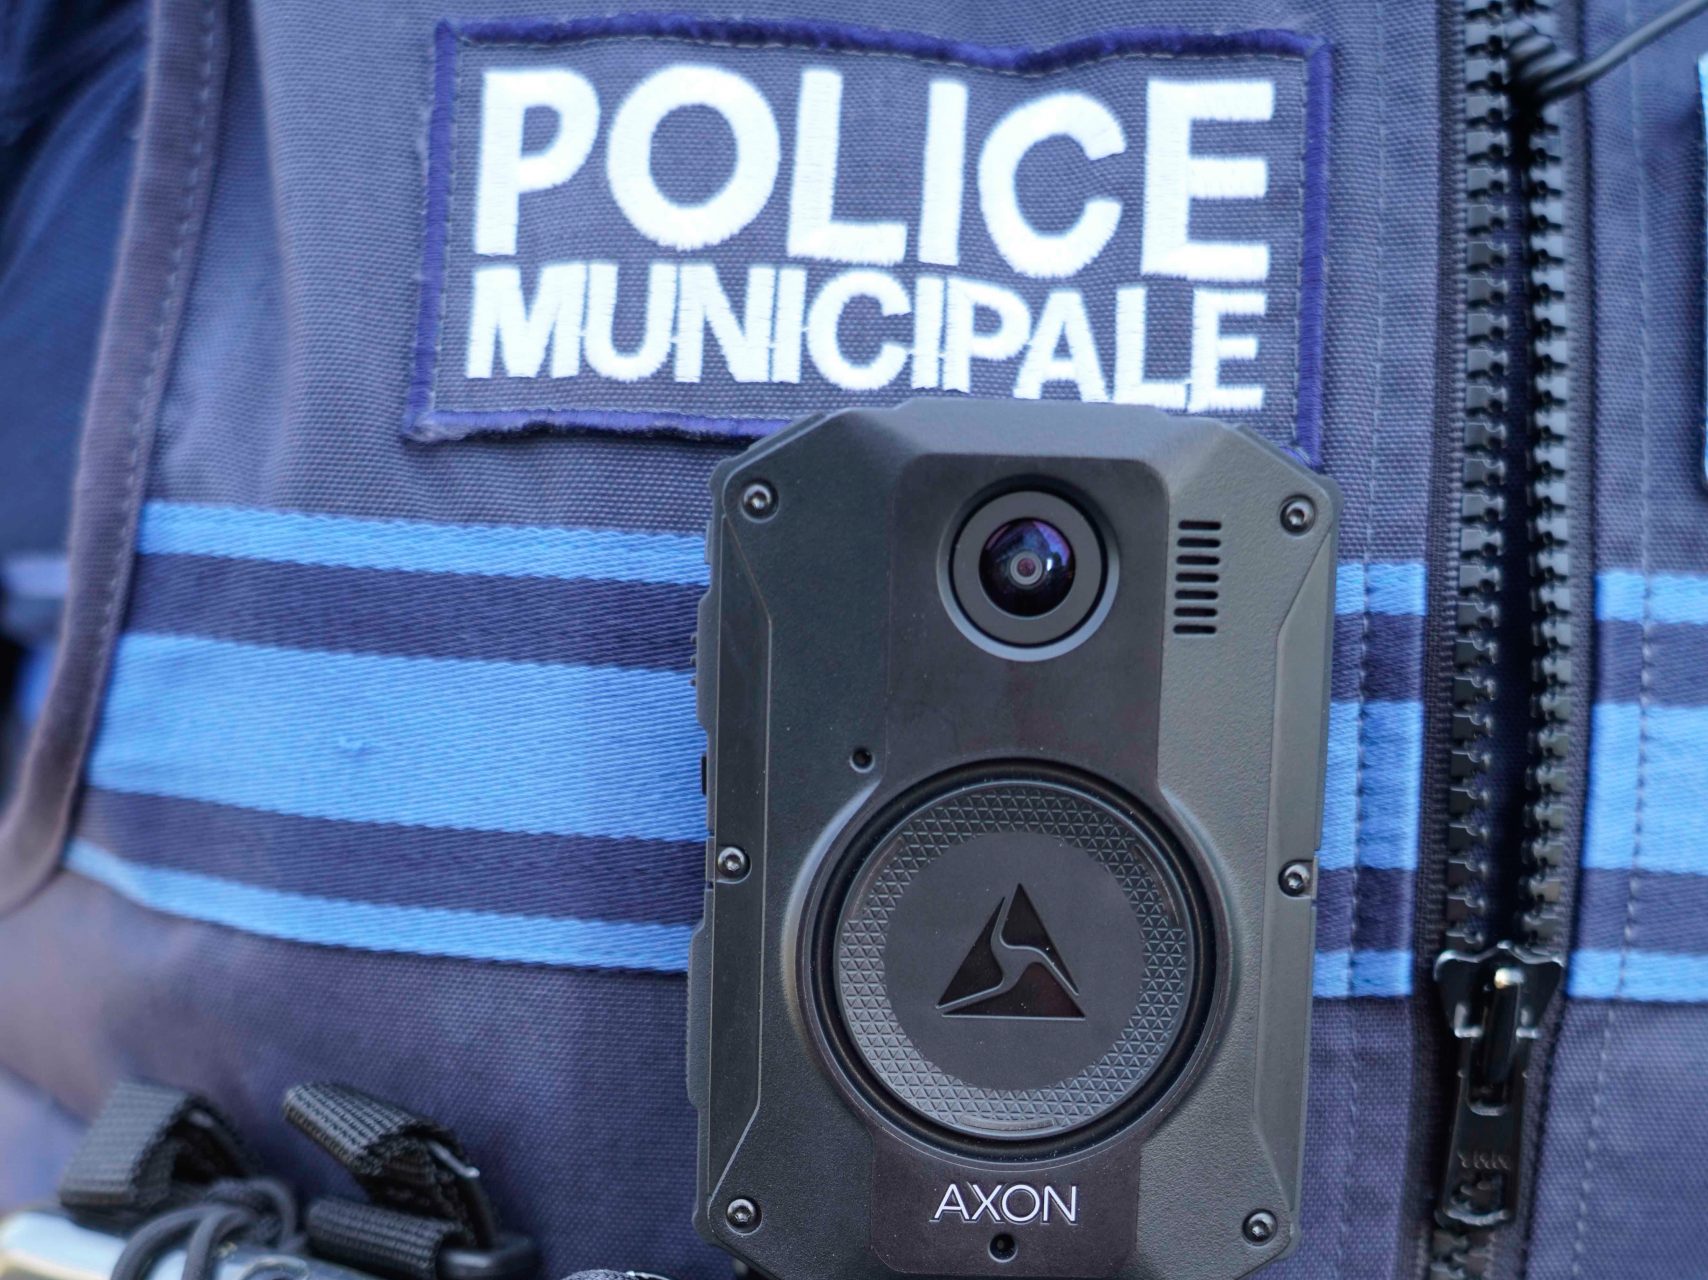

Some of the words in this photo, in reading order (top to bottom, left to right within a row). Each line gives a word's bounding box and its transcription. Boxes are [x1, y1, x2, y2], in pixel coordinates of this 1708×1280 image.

[472, 63, 1276, 282] POLICE
[464, 261, 1268, 413] MUNICIPALE
[932, 1182, 1078, 1223] AXON
